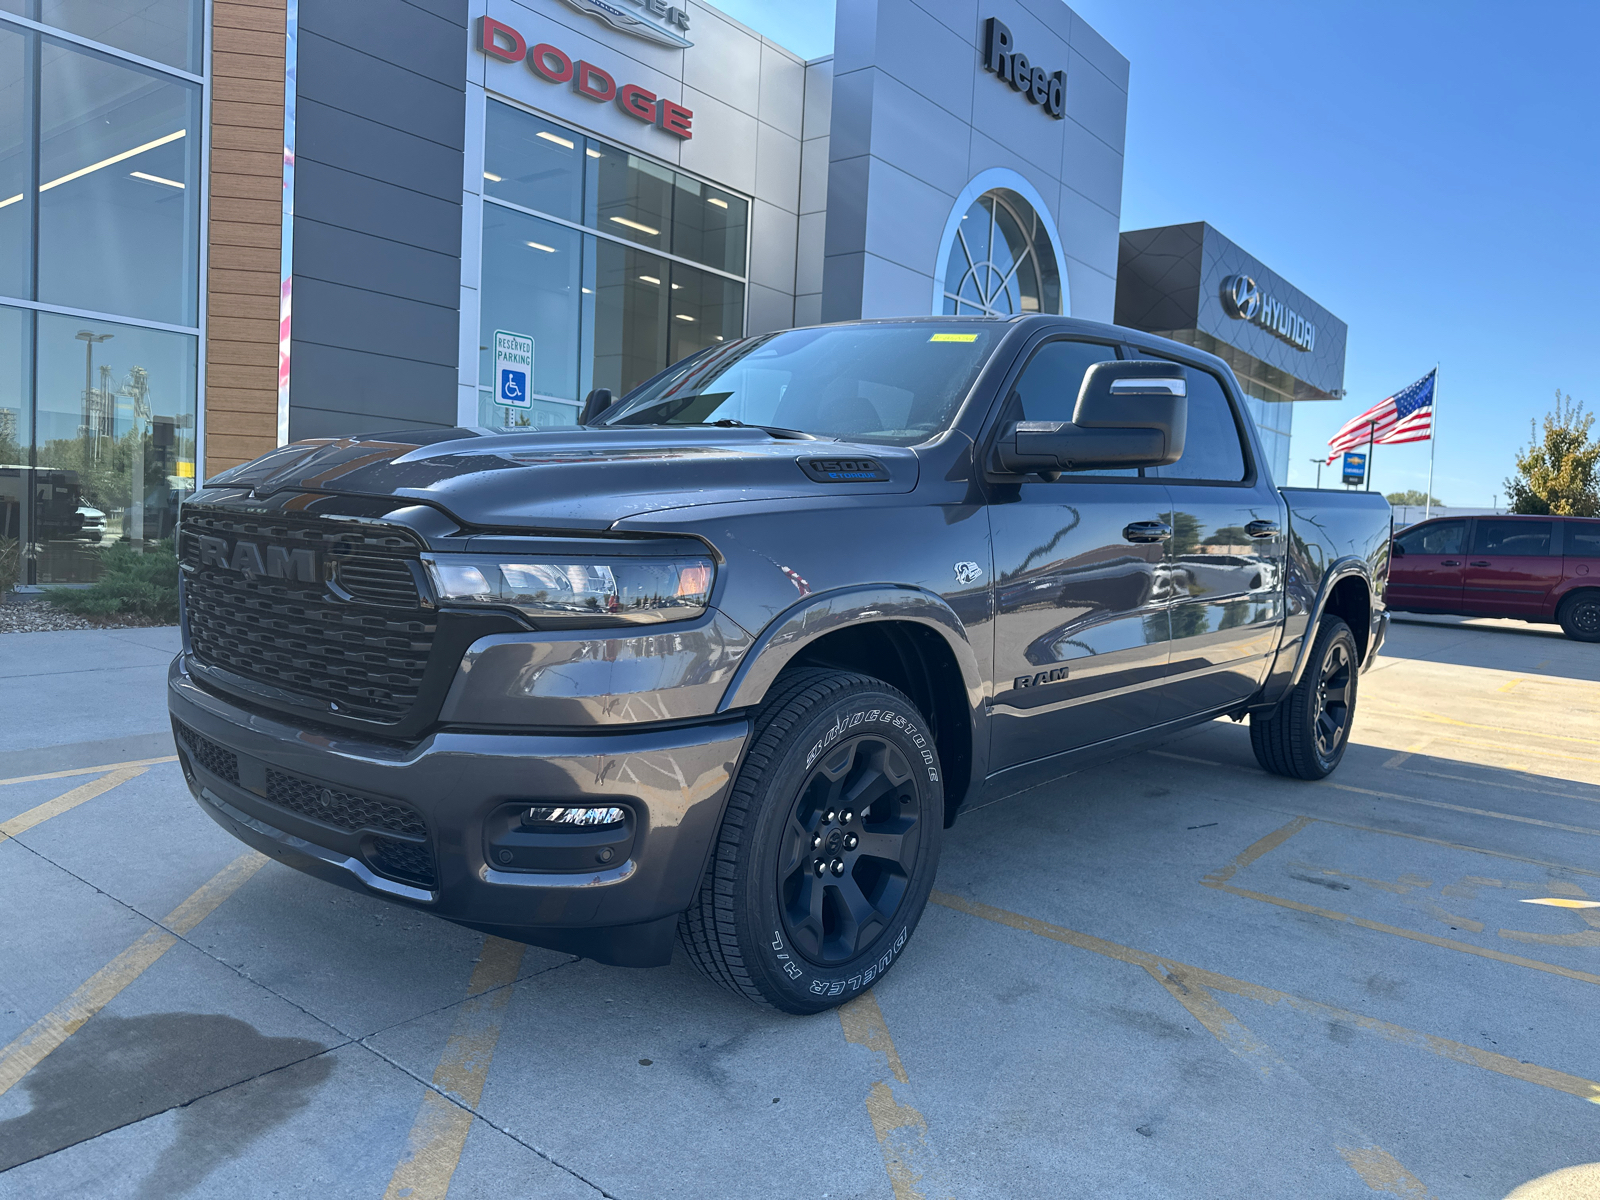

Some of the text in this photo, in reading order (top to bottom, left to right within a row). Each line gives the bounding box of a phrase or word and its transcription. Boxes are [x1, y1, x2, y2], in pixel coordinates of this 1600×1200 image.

[477, 15, 694, 140] DODGE
[984, 17, 1067, 120] Reed
[498, 337, 530, 353] RESERVED
[1261, 292, 1316, 352] HYUNDAI
[497, 350, 530, 366] PARKING
[811, 460, 876, 472] 1500
[199, 535, 316, 583] RAM
[1012, 666, 1070, 690] RAM
[805, 709, 939, 782] BRIDGESTONE
[771, 926, 908, 996] DUELER H/L
